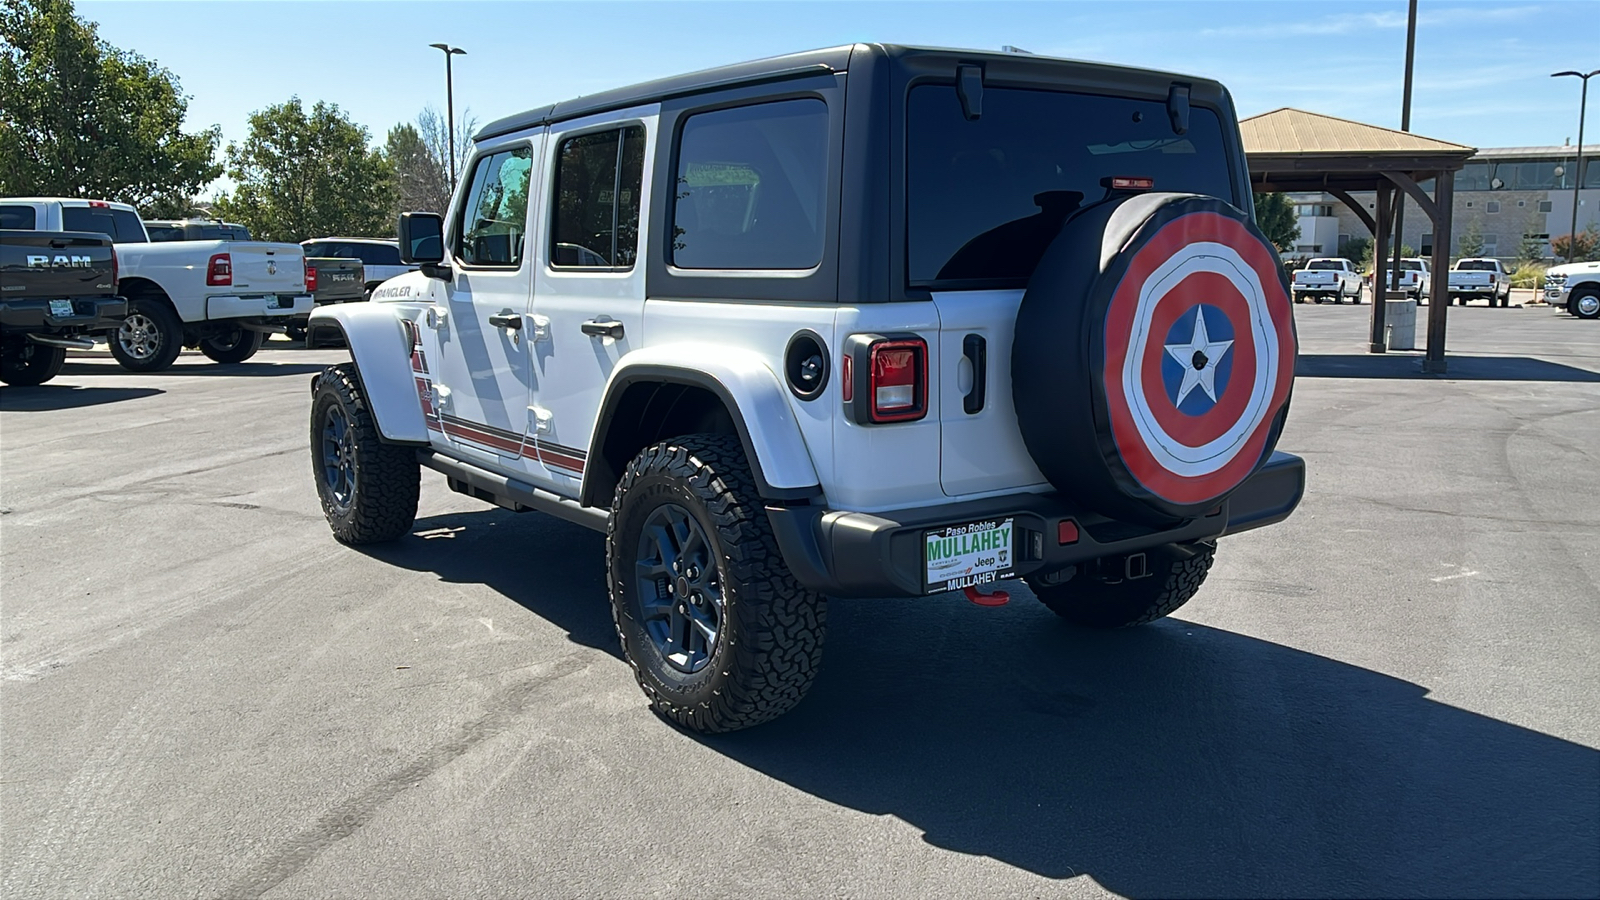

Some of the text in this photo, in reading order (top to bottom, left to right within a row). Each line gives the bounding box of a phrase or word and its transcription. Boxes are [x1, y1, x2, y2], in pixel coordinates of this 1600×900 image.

[26, 255, 92, 268] RAM
[373, 285, 411, 300] WRANGLER
[945, 527, 967, 537] Paso
[968, 521, 996, 533] Robles
[928, 528, 1010, 562] MULLAHEY
[974, 556, 995, 568] Jeep
[948, 571, 997, 591] MULLAHEY
